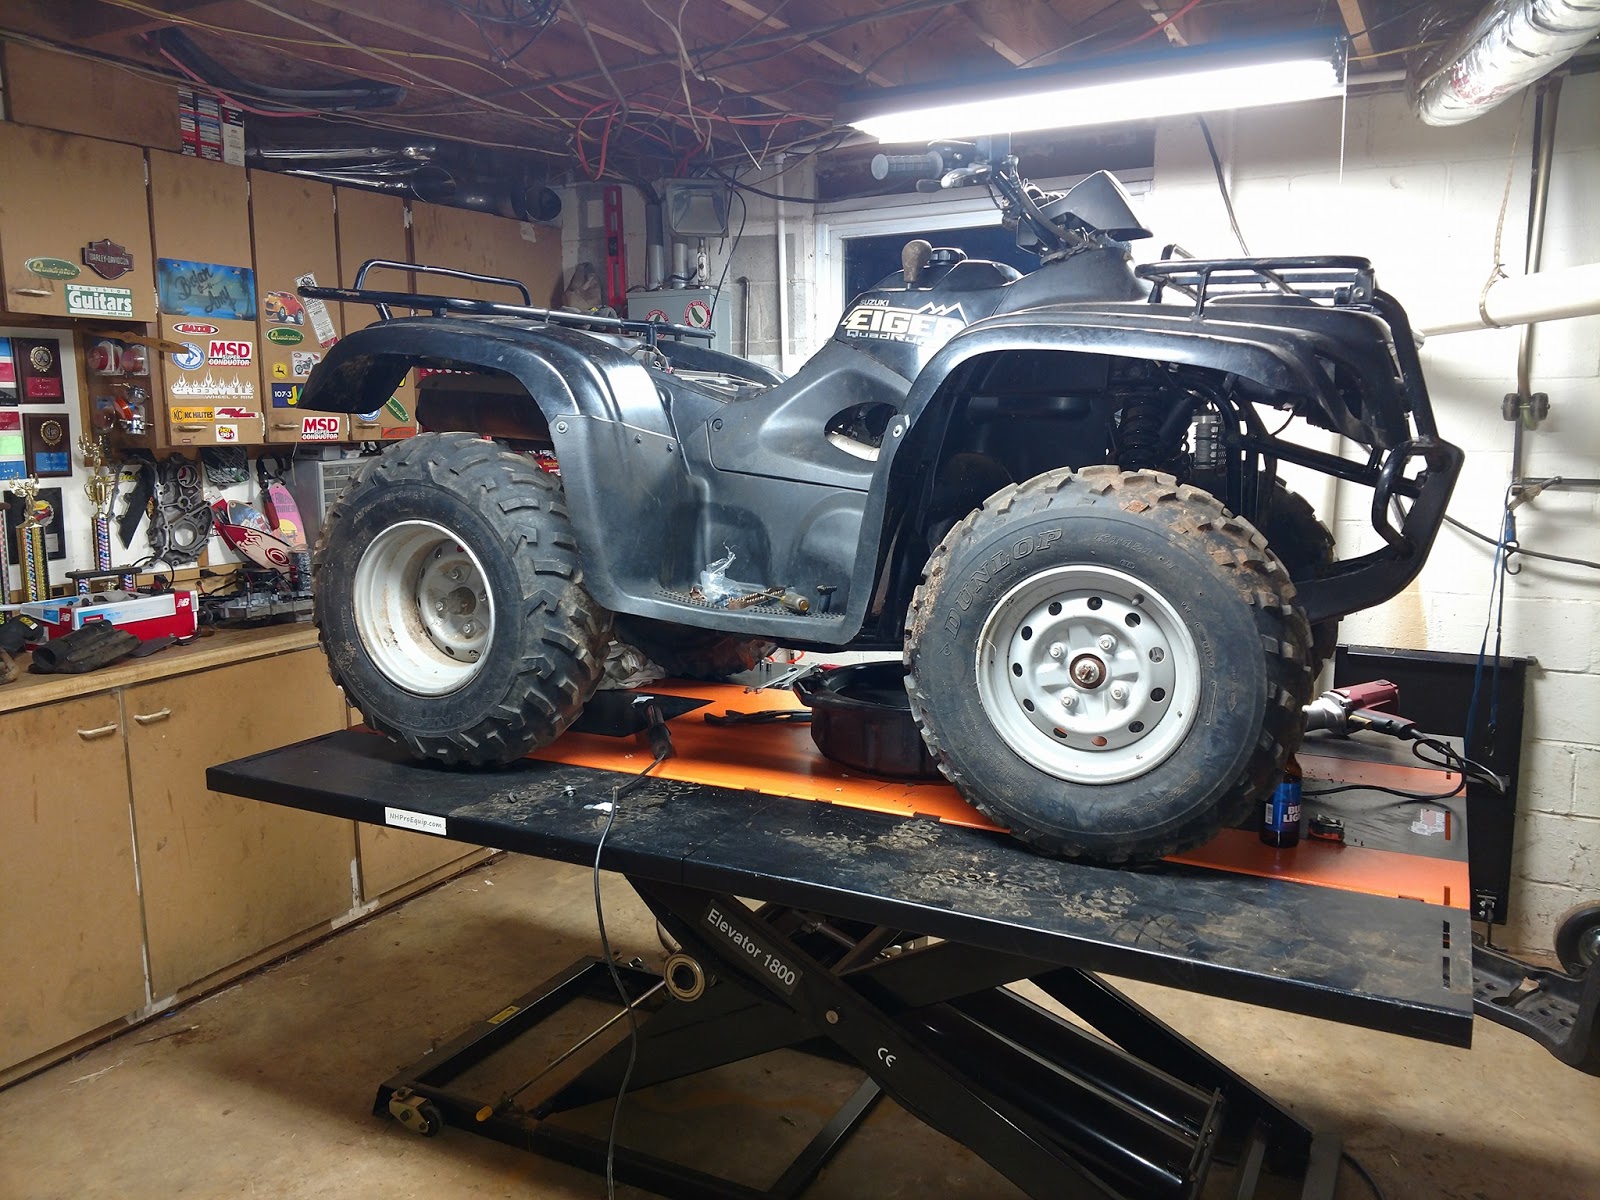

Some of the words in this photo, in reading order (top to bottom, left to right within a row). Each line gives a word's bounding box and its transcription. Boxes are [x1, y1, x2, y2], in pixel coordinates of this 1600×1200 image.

[68, 290, 132, 312] Guitars
[860, 299, 889, 307] SUZUKI
[210, 342, 251, 358] MSD
[208, 358, 251, 366] CONDUCTOR
[171, 382, 254, 395] GREENVILLE
[303, 418, 338, 432] MSD
[944, 528, 1063, 640] DUNLOP
[1287, 805, 1301, 815] BU
[389, 812, 443, 828] NHProEquip.com
[1282, 814, 1301, 822] LIG
[707, 908, 762, 958] Elevator
[763, 953, 796, 986] 1800
[877, 1047, 897, 1068] CE
